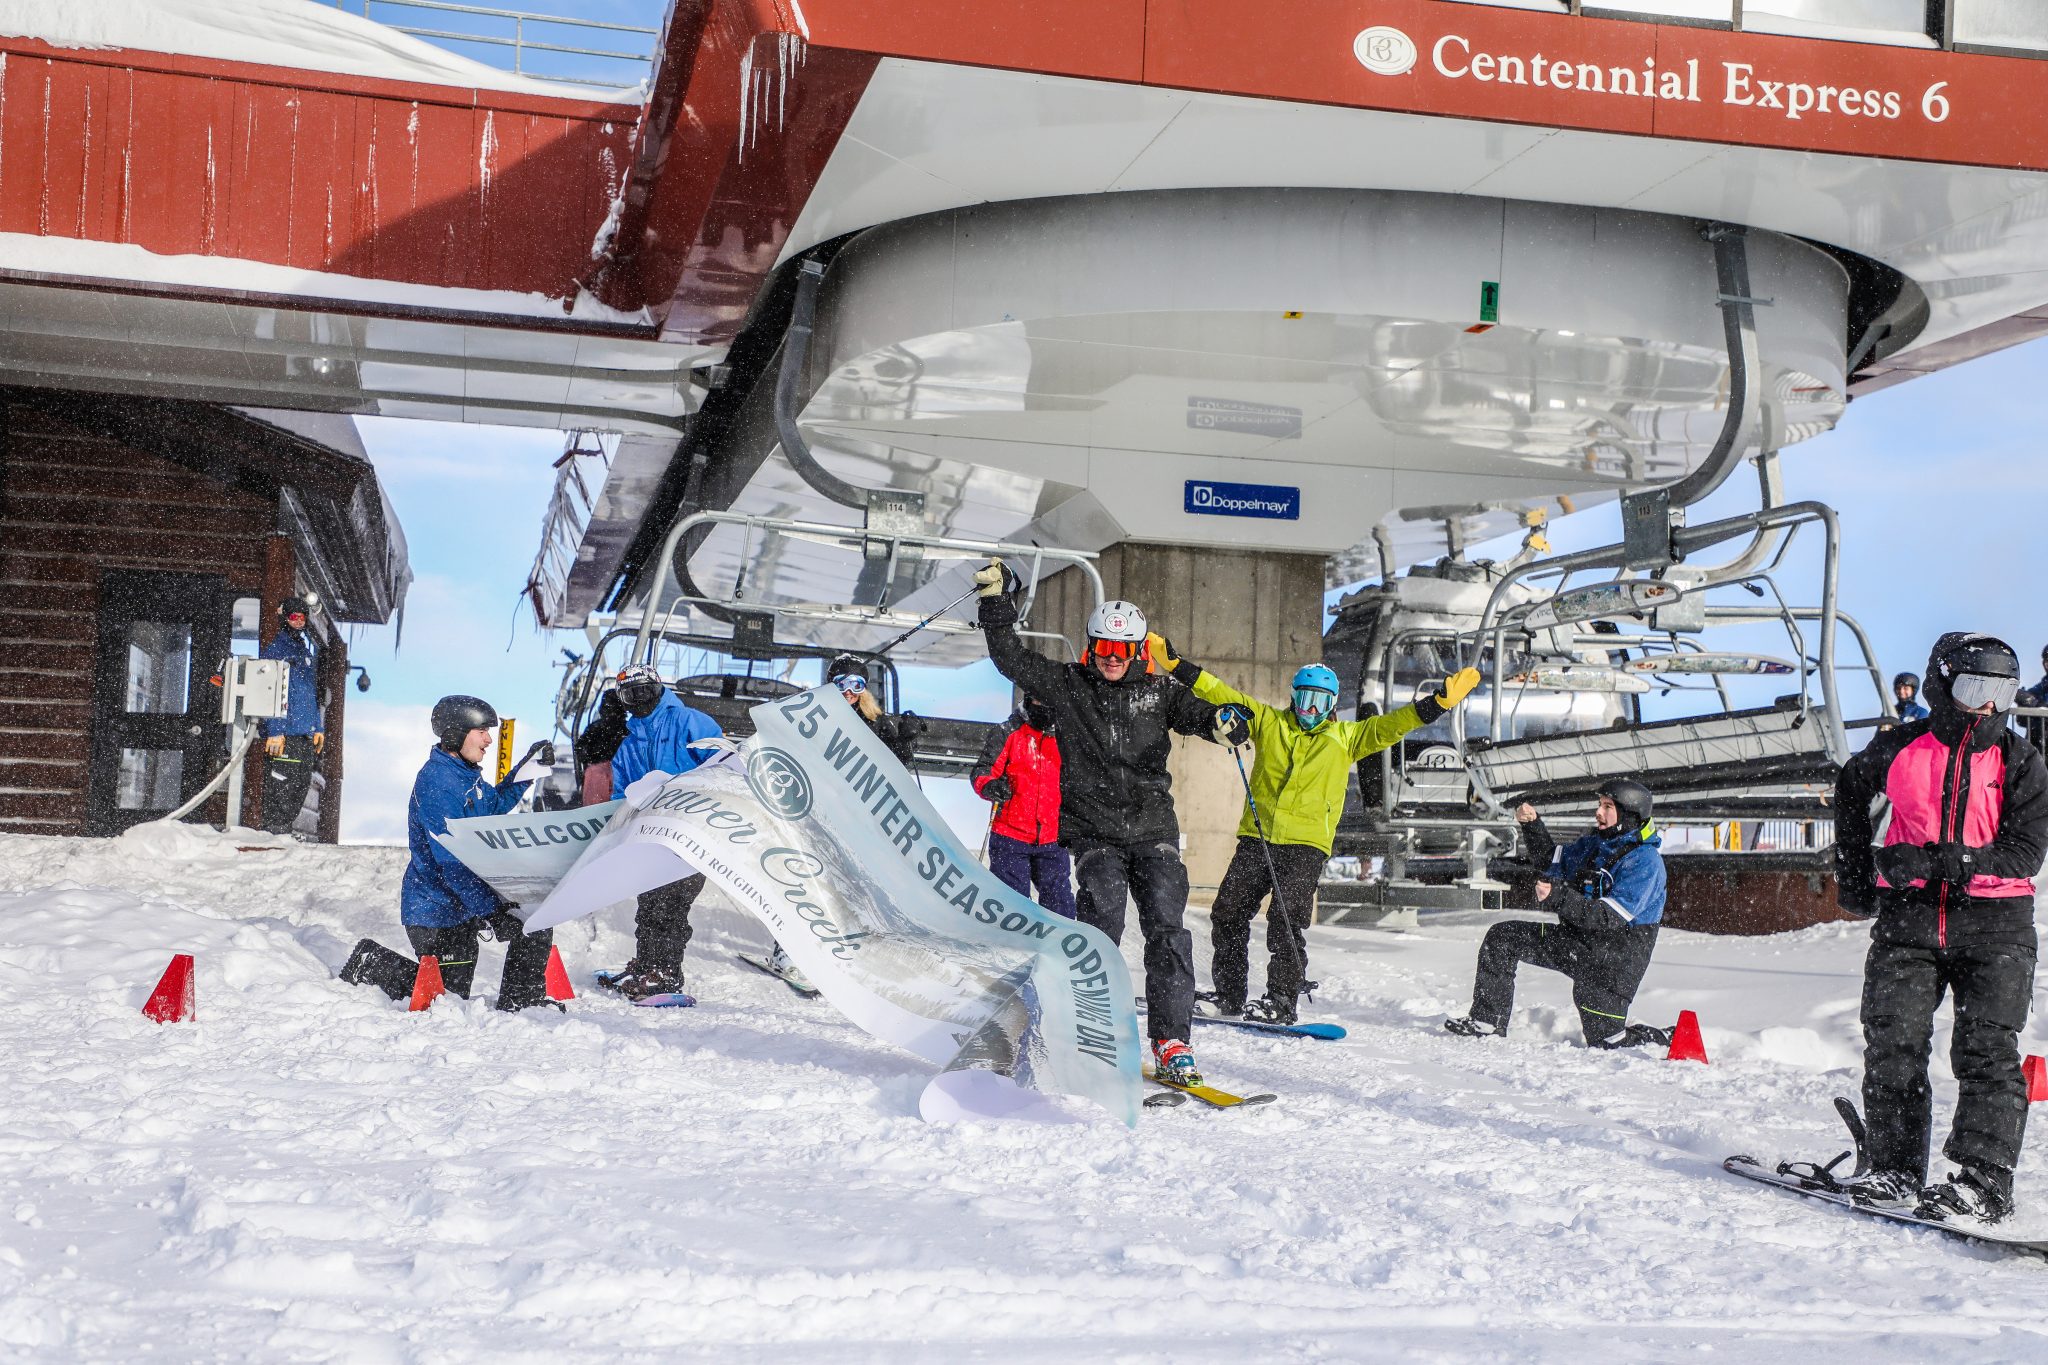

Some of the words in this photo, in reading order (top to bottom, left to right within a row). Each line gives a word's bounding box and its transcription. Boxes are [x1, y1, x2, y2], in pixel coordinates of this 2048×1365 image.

[1432, 35, 1701, 102] Centennial
[1723, 63, 1901, 120] Express
[1921, 82, 1950, 122] 6
[888, 503, 903, 512] 114
[1212, 496, 1290, 514] Doppelmayr
[499, 720, 509, 780] UNLOAD
[823, 727, 923, 857] WINTER
[656, 827, 710, 860] EXACTLY
[708, 857, 773, 915] ROUGHING
[770, 913, 786, 931] IT.
[760, 847, 870, 960] Creek
[917, 846, 1057, 940] SEASON
[1060, 933, 1114, 1027] OPENING
[1076, 1023, 1118, 1068] DAY
